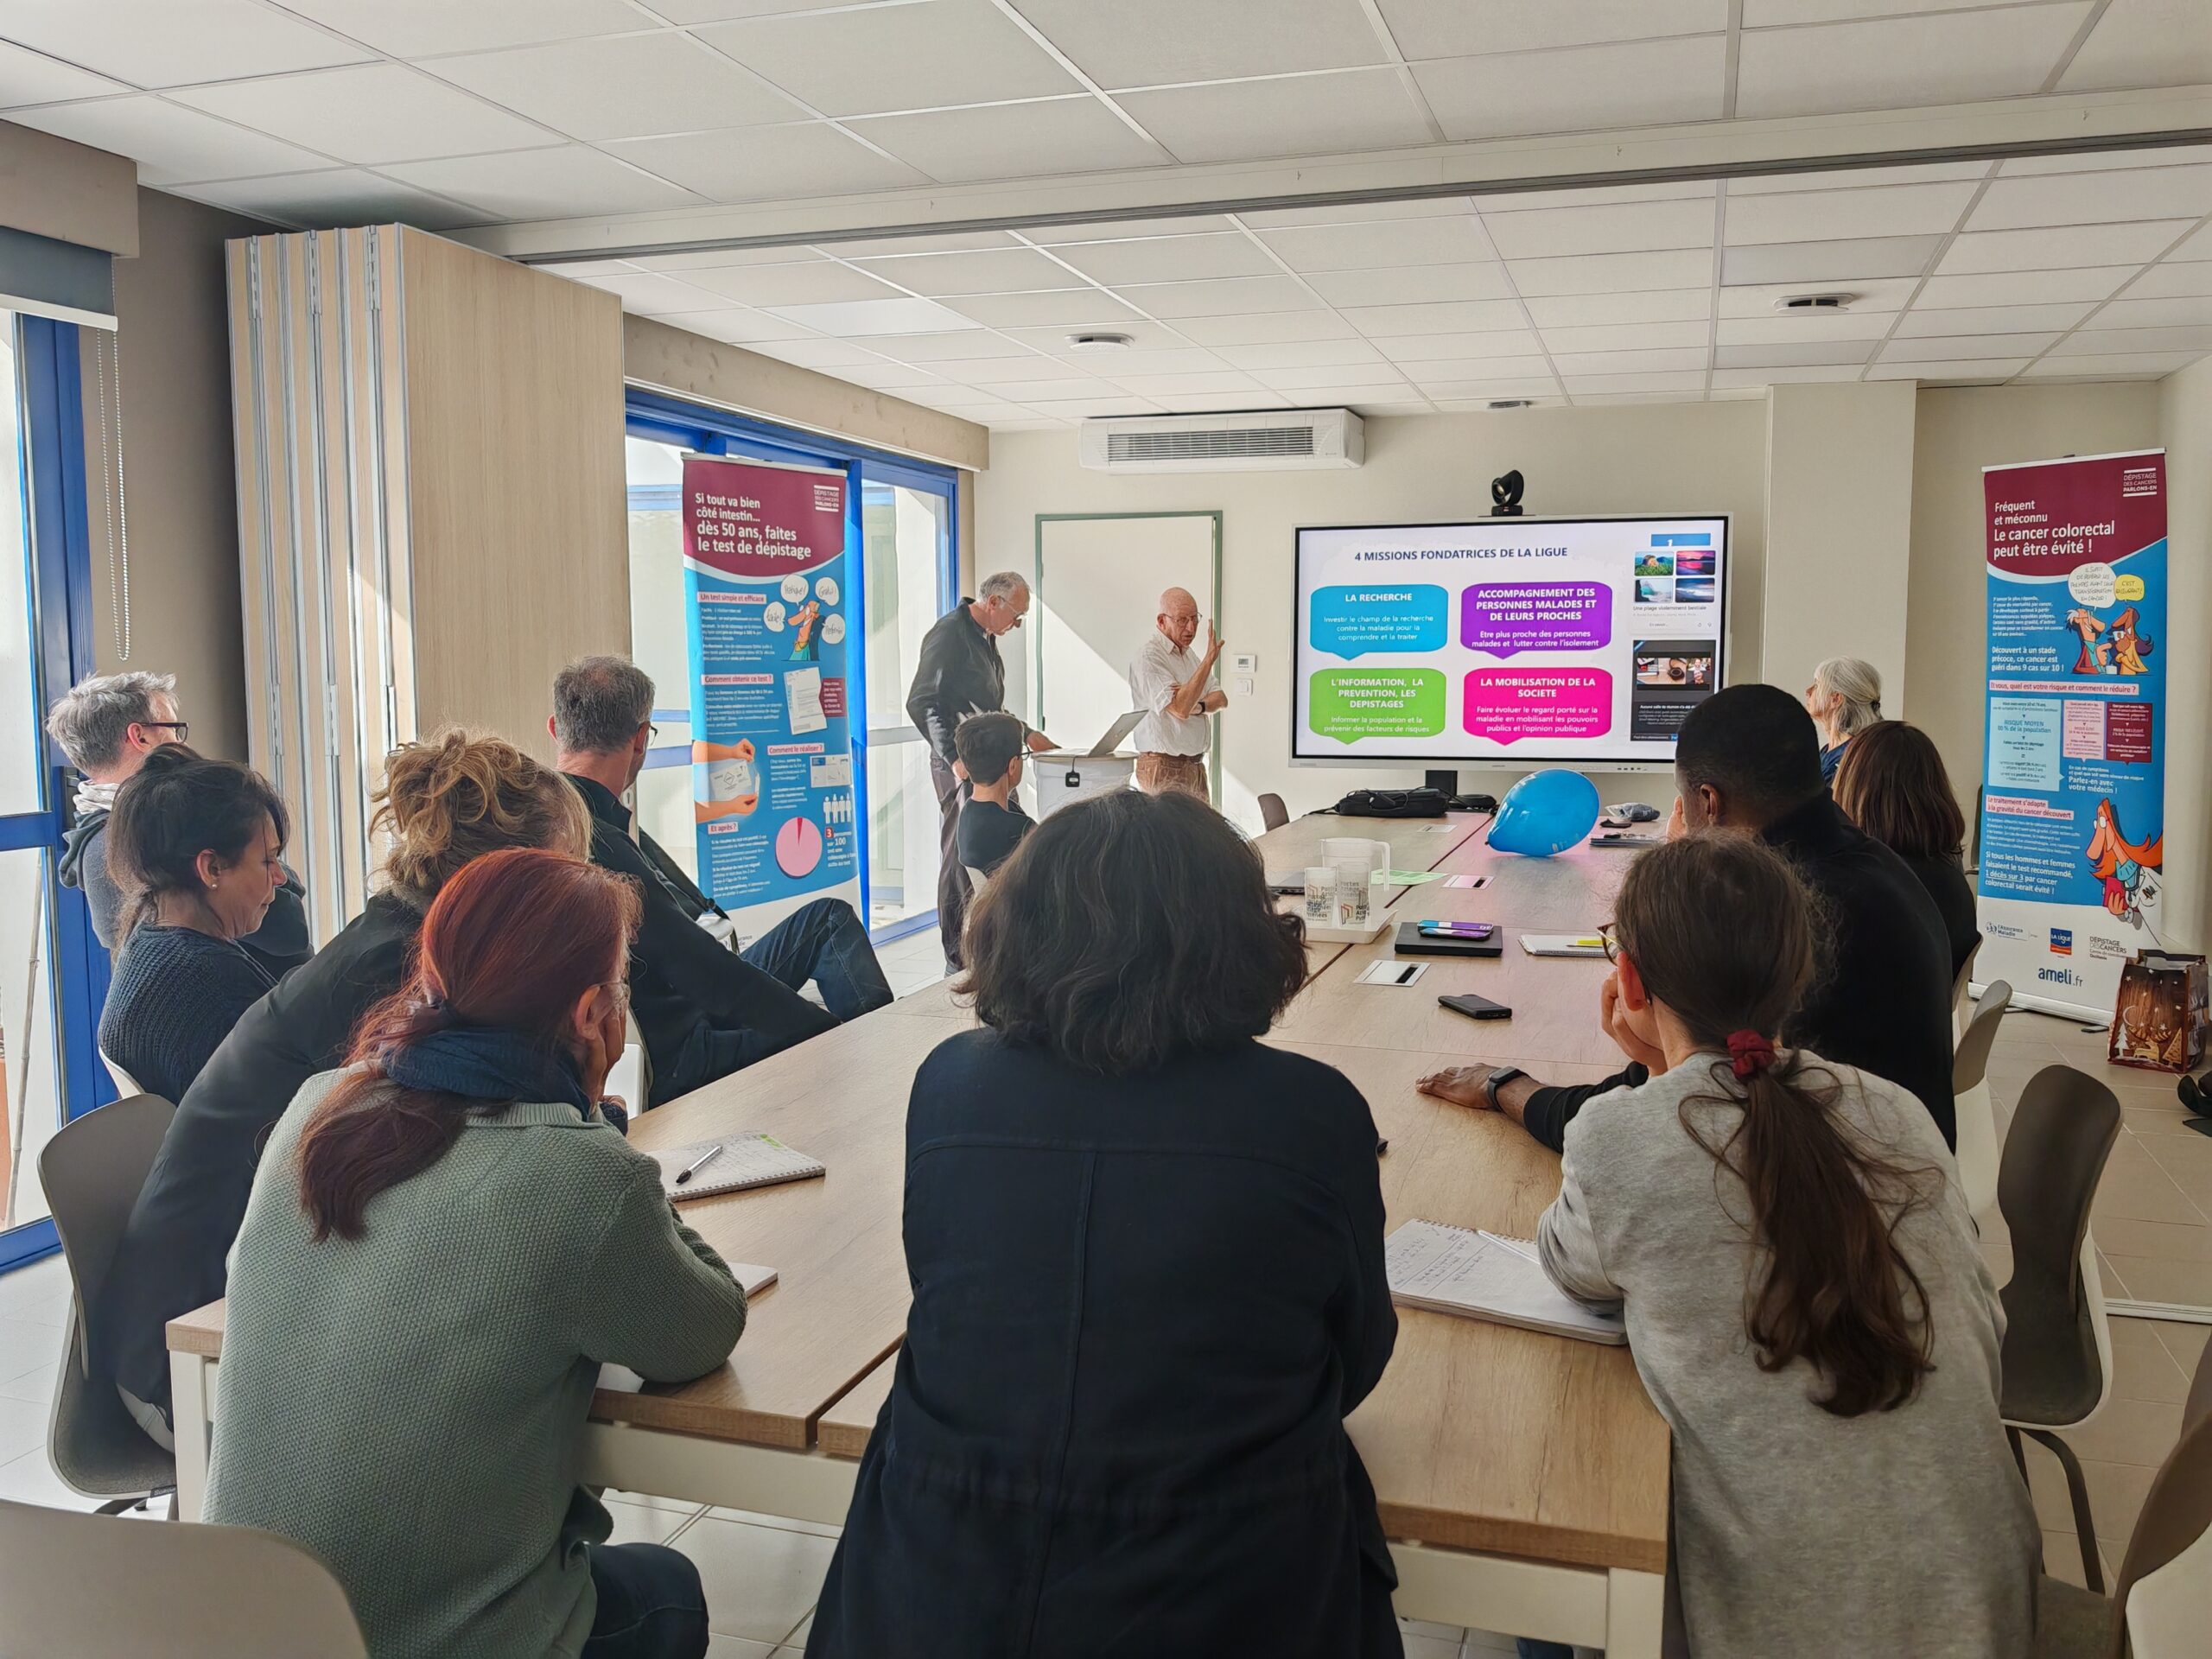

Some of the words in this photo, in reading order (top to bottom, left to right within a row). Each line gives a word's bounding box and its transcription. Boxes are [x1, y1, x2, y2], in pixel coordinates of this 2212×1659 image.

[696, 493, 704, 504] Si
[707, 494, 726, 506] tout
[728, 498, 738, 507] va
[740, 496, 760, 509] bien
[1995, 499, 2035, 513] Fréquent
[696, 507, 717, 519] côté
[1994, 516, 2003, 525] et
[2005, 513, 2048, 524] méconnu
[697, 520, 719, 536] dès
[722, 523, 735, 537] 50
[738, 527, 763, 541] ans,
[765, 525, 797, 541] faites
[1994, 530, 2005, 542] Le
[2009, 528, 2049, 541] cancer
[2051, 520, 2115, 537] colorectal
[698, 537, 710, 551] le
[713, 538, 734, 553] test
[738, 540, 753, 554] de
[756, 541, 811, 560] dépistage
[1993, 544, 2019, 560] peut
[2023, 541, 2048, 556] être
[2051, 538, 2084, 555] évité
[2088, 538, 2092, 553] !
[1355, 552, 1361, 562] 4
[1364, 551, 1418, 561] MISSIONS
[1421, 549, 1497, 560] FONDATRICES
[1500, 549, 1514, 558] DE
[1518, 548, 1532, 557] LA
[1535, 547, 1567, 556] LIGUE
[1345, 594, 1357, 602] LA
[1359, 593, 1413, 602] RECHERCHE
[1478, 588, 1573, 598] ACCOMPAGNEMENT
[1576, 588, 1596, 597] DES
[1476, 601, 1533, 610] PERSONNES
[1535, 600, 1583, 609] MALADES
[1585, 600, 1597, 608] ET
[1357, 615, 1380, 624] champ
[1490, 613, 1502, 621] DE
[1504, 612, 1535, 620] LEURS
[1536, 611, 1582, 620] PROCHES
[1338, 633, 1379, 642] comprendre
[1495, 631, 1510, 639] plus
[1512, 631, 1536, 639] proche
[1331, 678, 1407, 688] L'INFORMATION,
[1480, 677, 1493, 687] LA
[1495, 677, 1566, 687] MOBILISATION
[1567, 677, 1580, 686] DE
[1583, 677, 1596, 686] LA
[1338, 690, 1399, 699] PREVENTION,
[1517, 689, 1557, 697] SOCIETE
[1350, 700, 1404, 709] DEPISTAGES
[1531, 706, 1555, 715] regard
[1557, 705, 1575, 715] porté
[1369, 716, 1406, 725] population
[1567, 715, 1599, 725] pouvoirs
[1324, 725, 1351, 734] prévenir
[1486, 725, 1512, 734] publics
[1522, 725, 1553, 734] l'opinion
[1554, 725, 1586, 734] publique
[2087, 785, 2113, 794] médecin
[827, 829, 831, 837] 3
[836, 837, 847, 846] 100
[2015, 855, 2041, 864] hommes
[2037, 877, 2057, 886] cancer
[2016, 882, 2033, 892] serait
[2035, 885, 2050, 893] évité
[2038, 967, 2083, 988] ameli.fr
